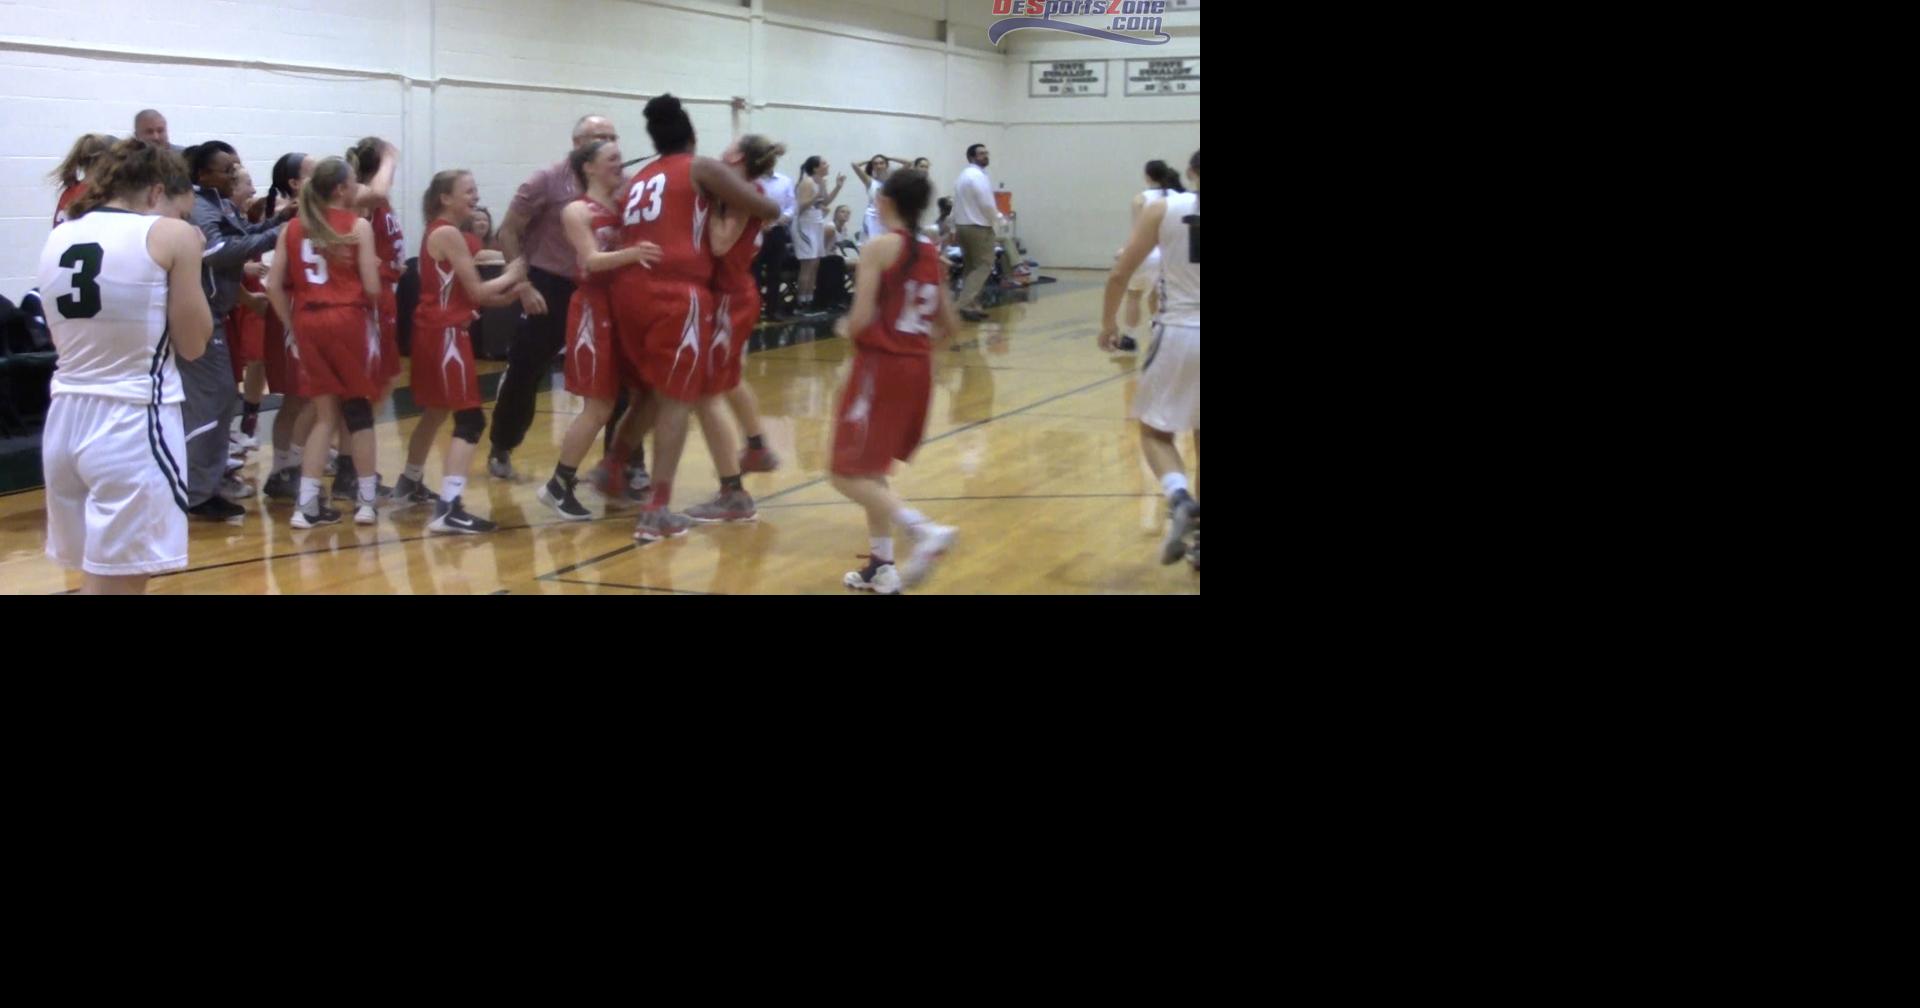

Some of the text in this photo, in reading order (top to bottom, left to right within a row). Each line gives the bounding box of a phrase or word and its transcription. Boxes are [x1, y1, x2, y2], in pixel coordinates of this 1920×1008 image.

[624, 172, 666, 226] 23
[56, 242, 104, 319] 3
[302, 238, 329, 285] 5
[896, 279, 939, 334] 12
